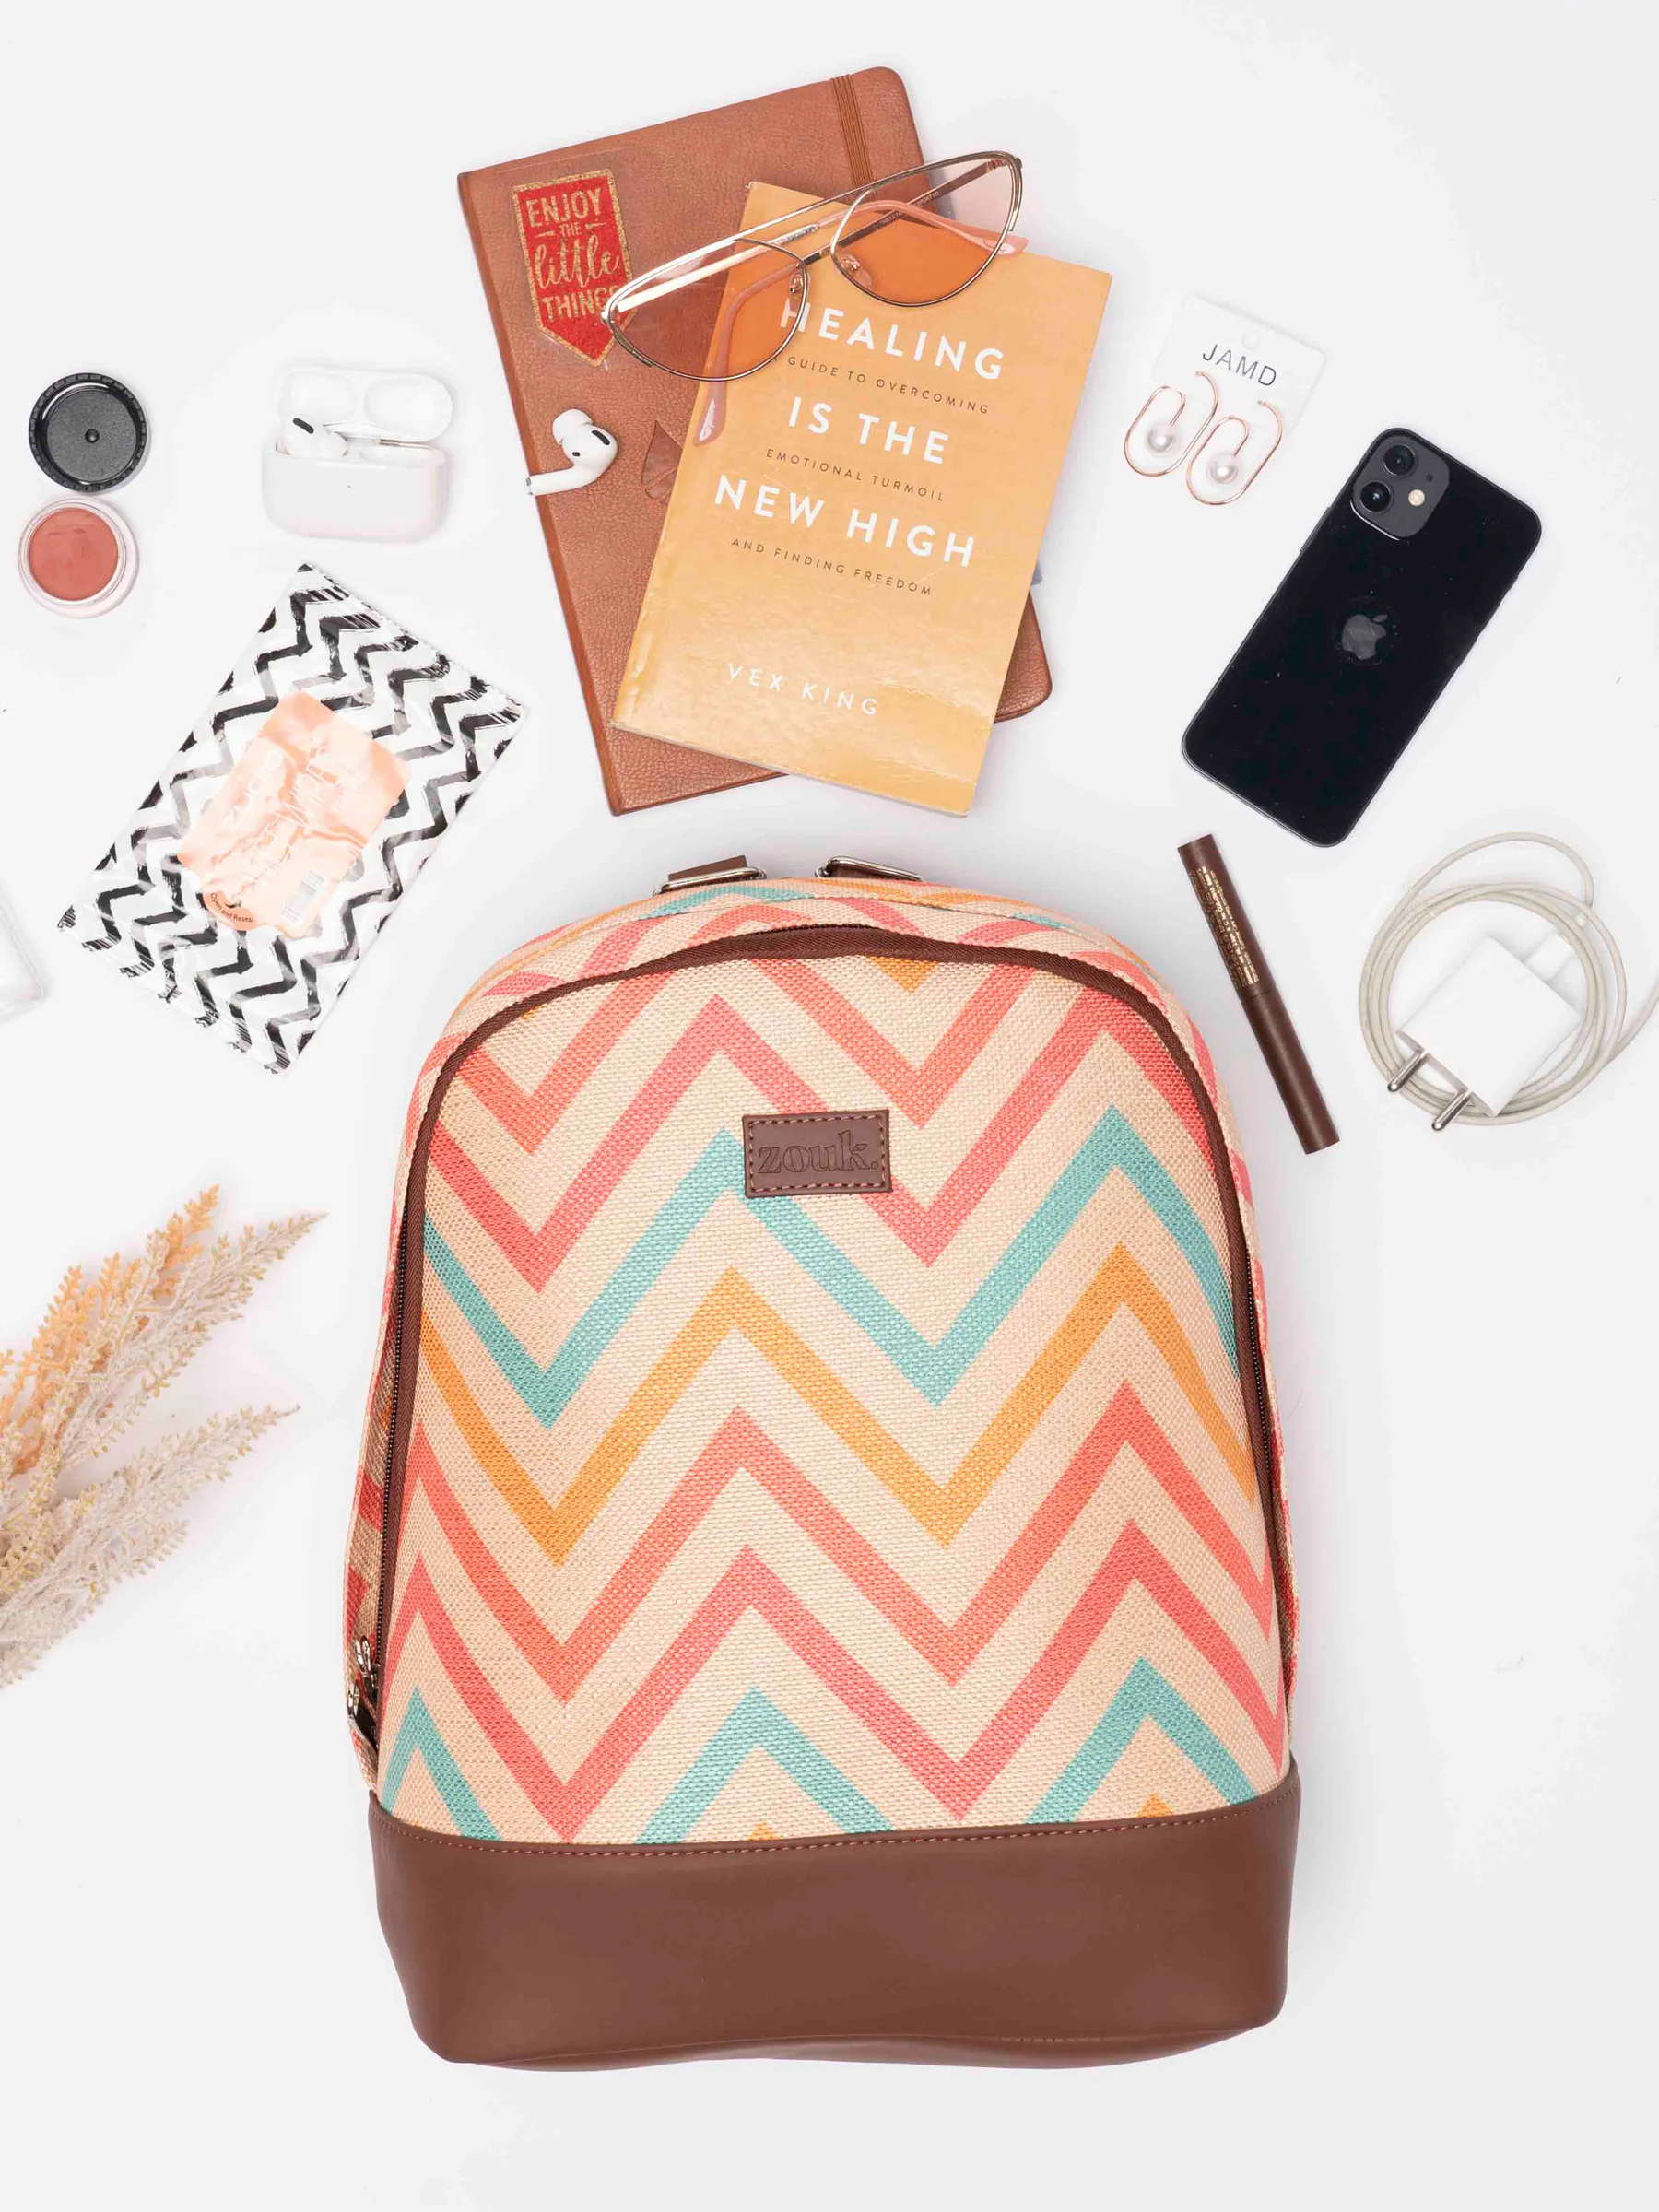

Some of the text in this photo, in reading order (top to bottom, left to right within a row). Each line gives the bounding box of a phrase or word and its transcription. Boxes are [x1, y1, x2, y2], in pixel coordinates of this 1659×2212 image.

[525, 188, 602, 228] ENJOY
[559, 222, 582, 238] THE
[533, 234, 619, 289] little
[780, 298, 1004, 380] HEALING
[1202, 344, 1277, 386] JAMD
[788, 356, 989, 414] GUIDE TO OVERCOMING
[788, 396, 948, 465] IS THE
[767, 448, 944, 501] EMOTIONAL TURMOIL
[714, 474, 974, 567] NEW HIGH
[731, 538, 932, 595] AND FINDING FREEDOM
[727, 662, 877, 715] VEX KING
[210, 892, 222, 911] Open
[221, 909, 233, 919] and
[758, 1129, 879, 1174] zouk.
